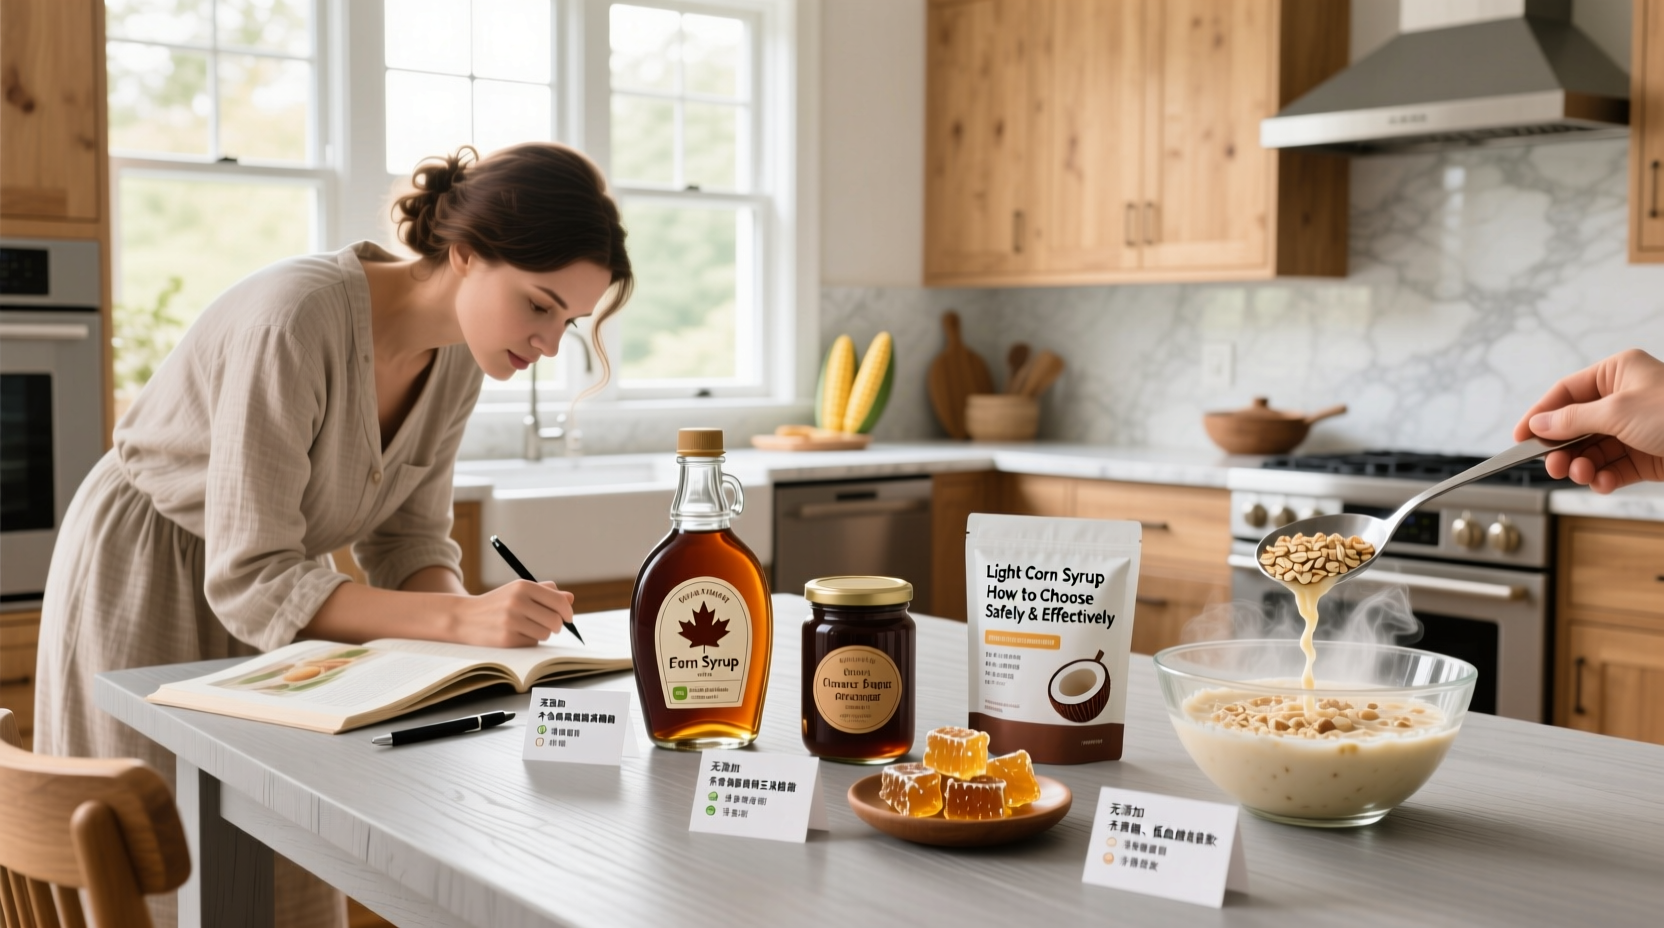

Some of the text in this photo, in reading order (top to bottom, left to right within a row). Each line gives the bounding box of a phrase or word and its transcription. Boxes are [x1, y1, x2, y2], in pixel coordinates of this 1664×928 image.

[986, 564, 1105, 588] Light Corn Syrup
[986, 585, 1094, 605] How to Choose
[985, 604, 1116, 630] Safely & Effectively
[702, 655, 739, 672] Syrup
